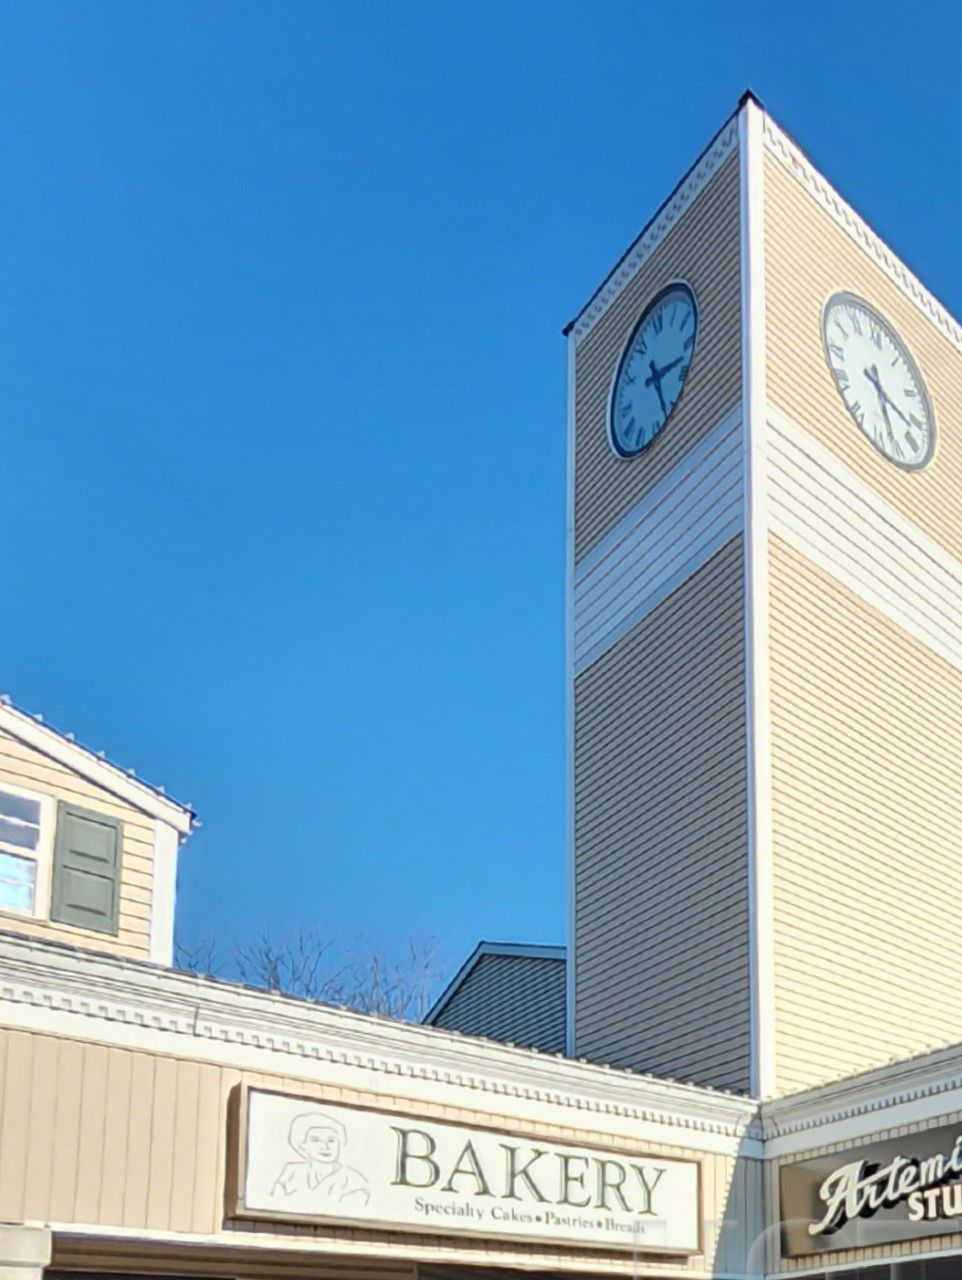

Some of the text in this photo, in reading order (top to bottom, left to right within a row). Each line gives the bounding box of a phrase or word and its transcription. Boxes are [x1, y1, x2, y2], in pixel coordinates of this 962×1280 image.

[389, 1126, 667, 1217] BAKERY
[414, 1198, 645, 1234] Specialty Cakes Pastries Breads
